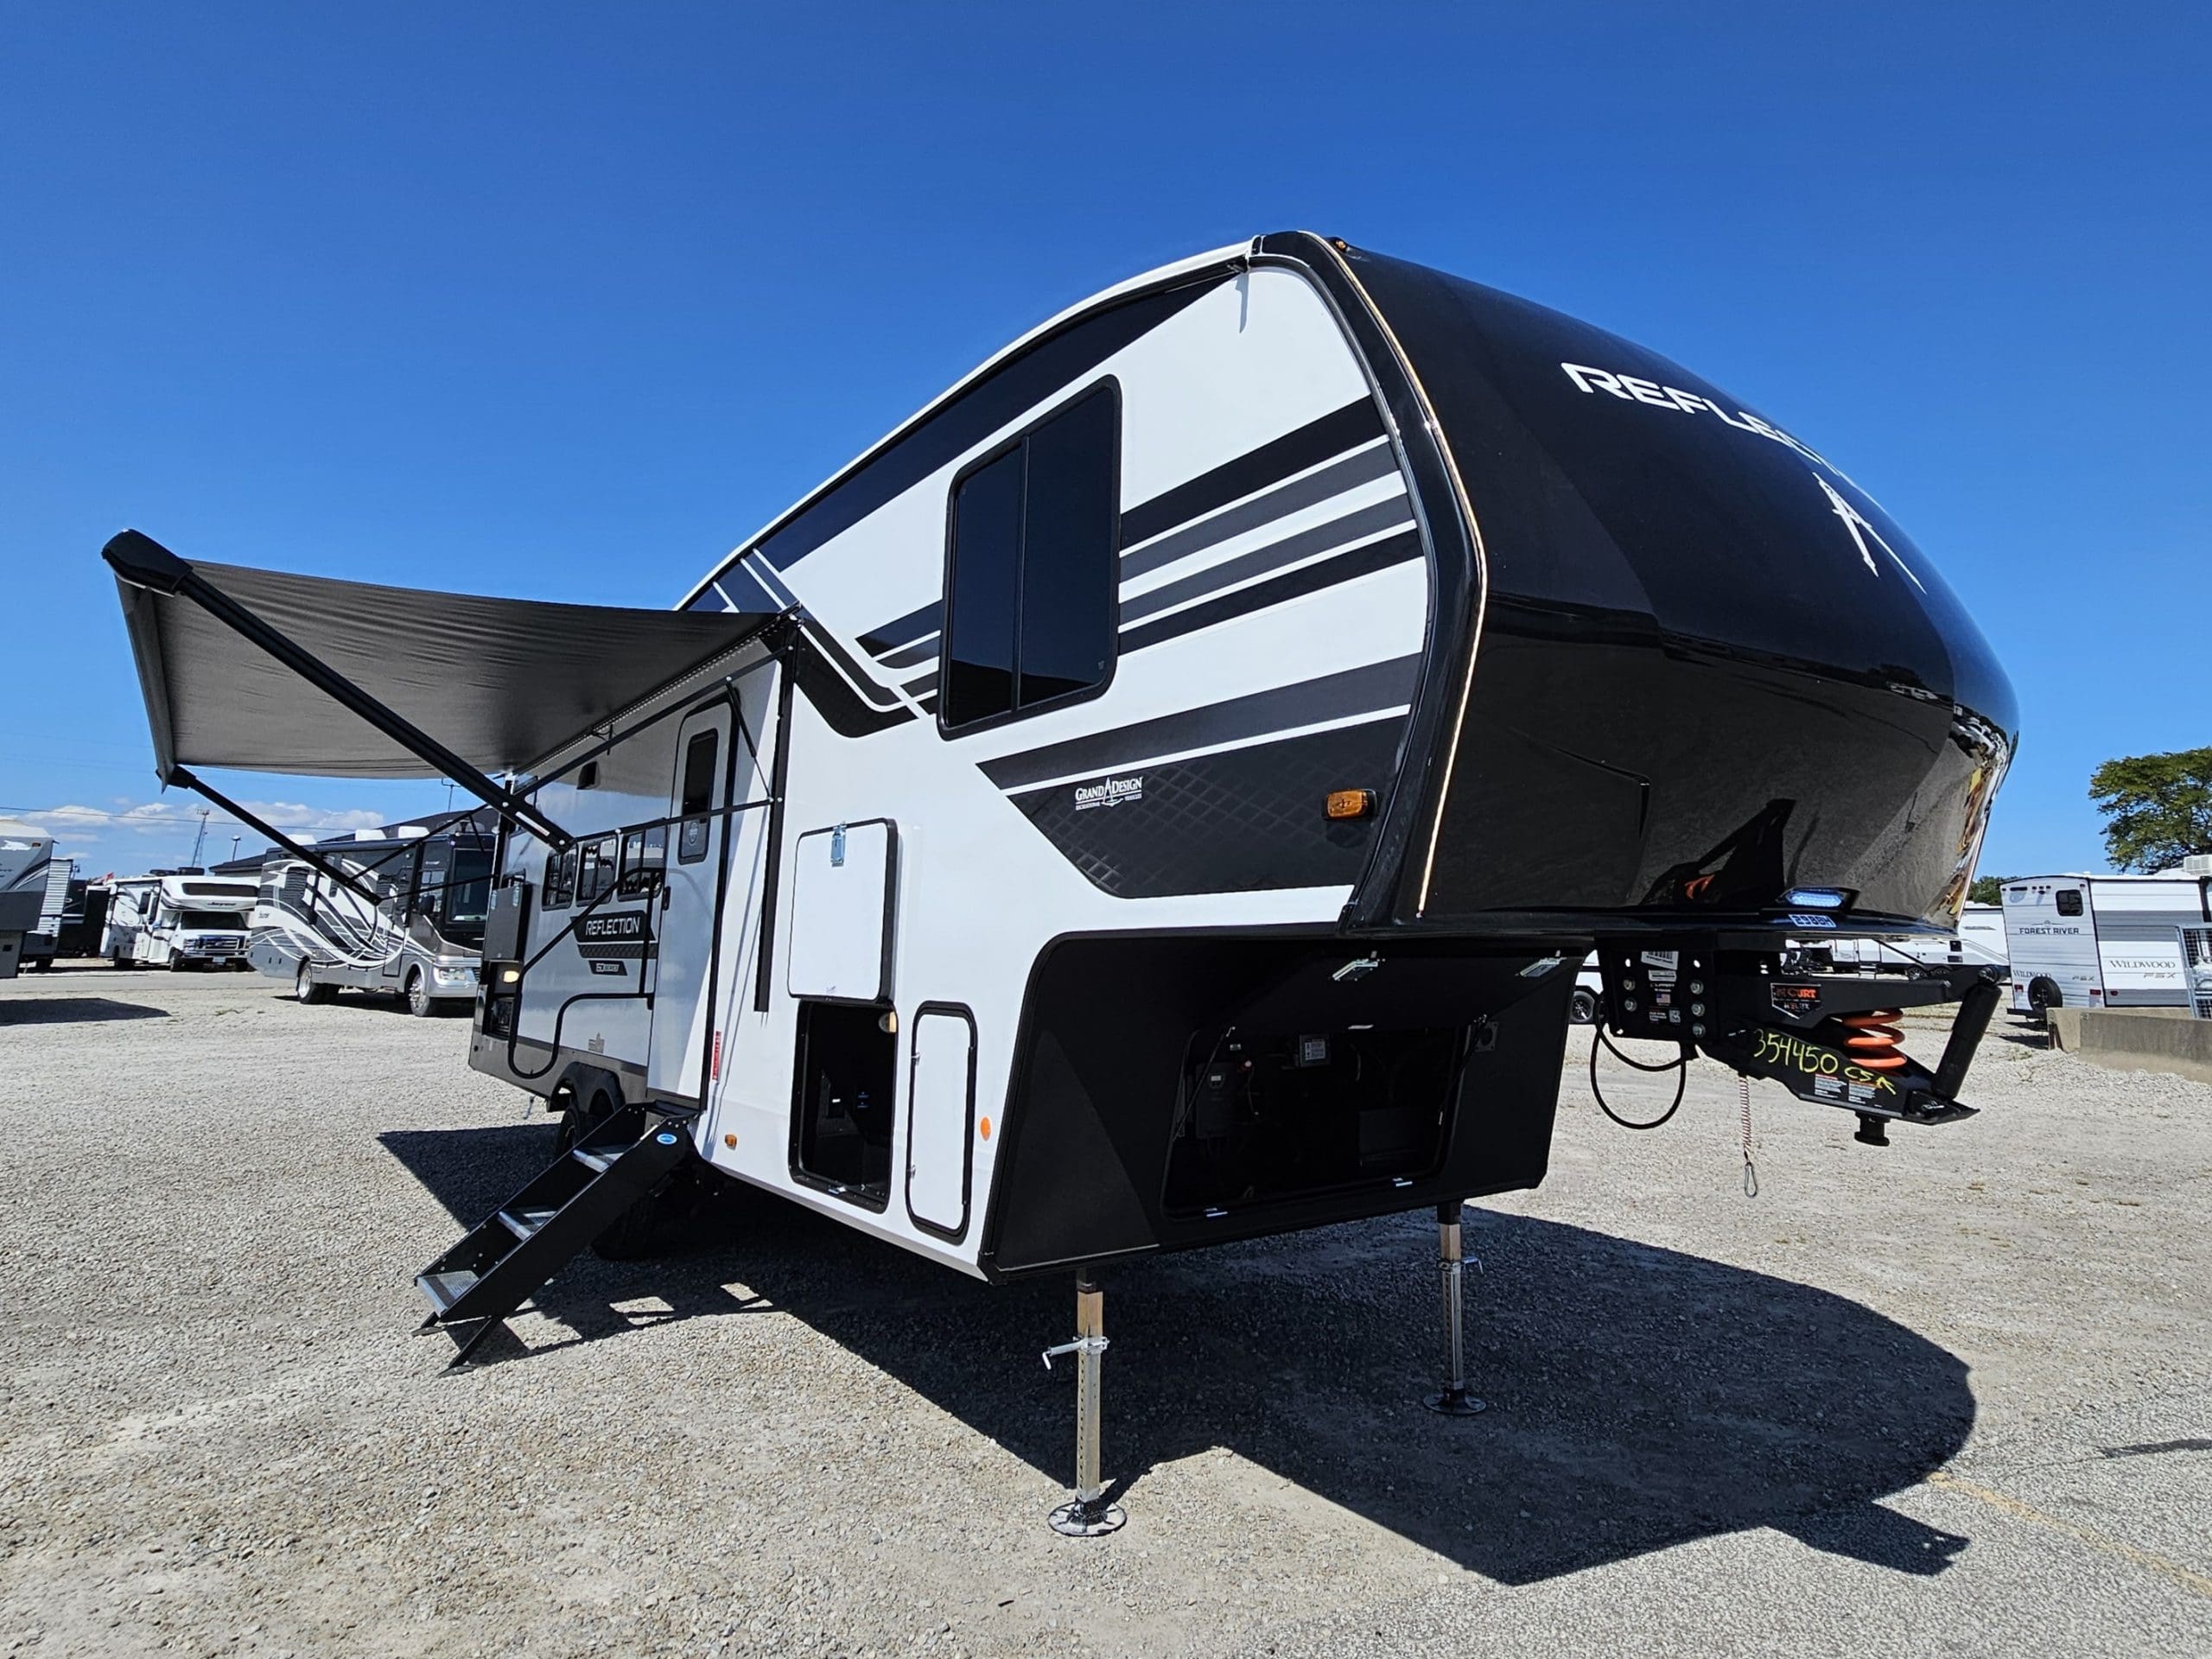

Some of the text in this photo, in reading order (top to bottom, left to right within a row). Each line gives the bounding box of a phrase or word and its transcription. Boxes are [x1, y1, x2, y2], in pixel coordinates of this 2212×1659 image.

[1075, 776, 1143, 801] GRAND DESIGN
[585, 916, 640, 936] REFLECTION
[2109, 960, 2176, 969] WILDWOOD
[1788, 988, 1817, 999] CURT
[1753, 1028, 1839, 1074] 354450
